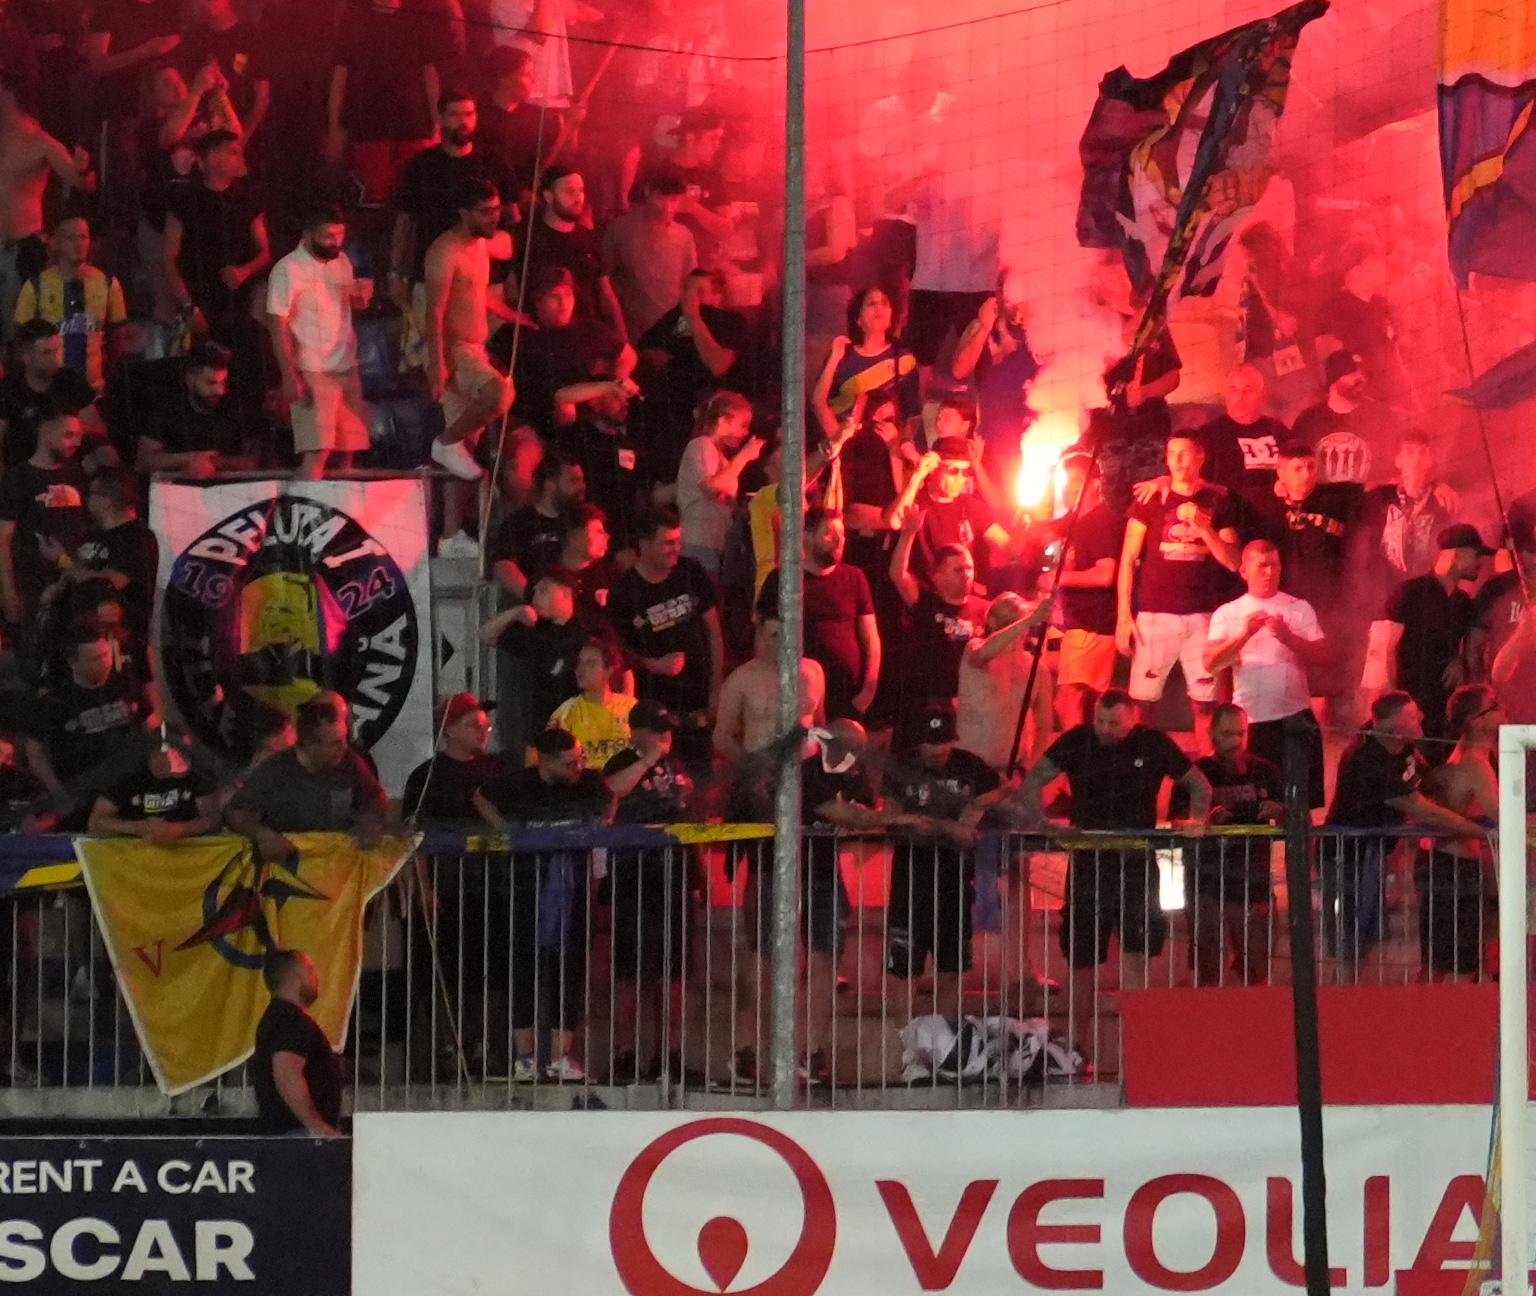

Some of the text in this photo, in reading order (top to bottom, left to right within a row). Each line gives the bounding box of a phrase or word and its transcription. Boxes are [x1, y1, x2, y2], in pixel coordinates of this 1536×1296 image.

[336, 565, 397, 621] 24
[111, 1160, 148, 1193] A
[157, 1160, 255, 1194] CAR
[875, 1173, 1494, 1291] VEOLIA
